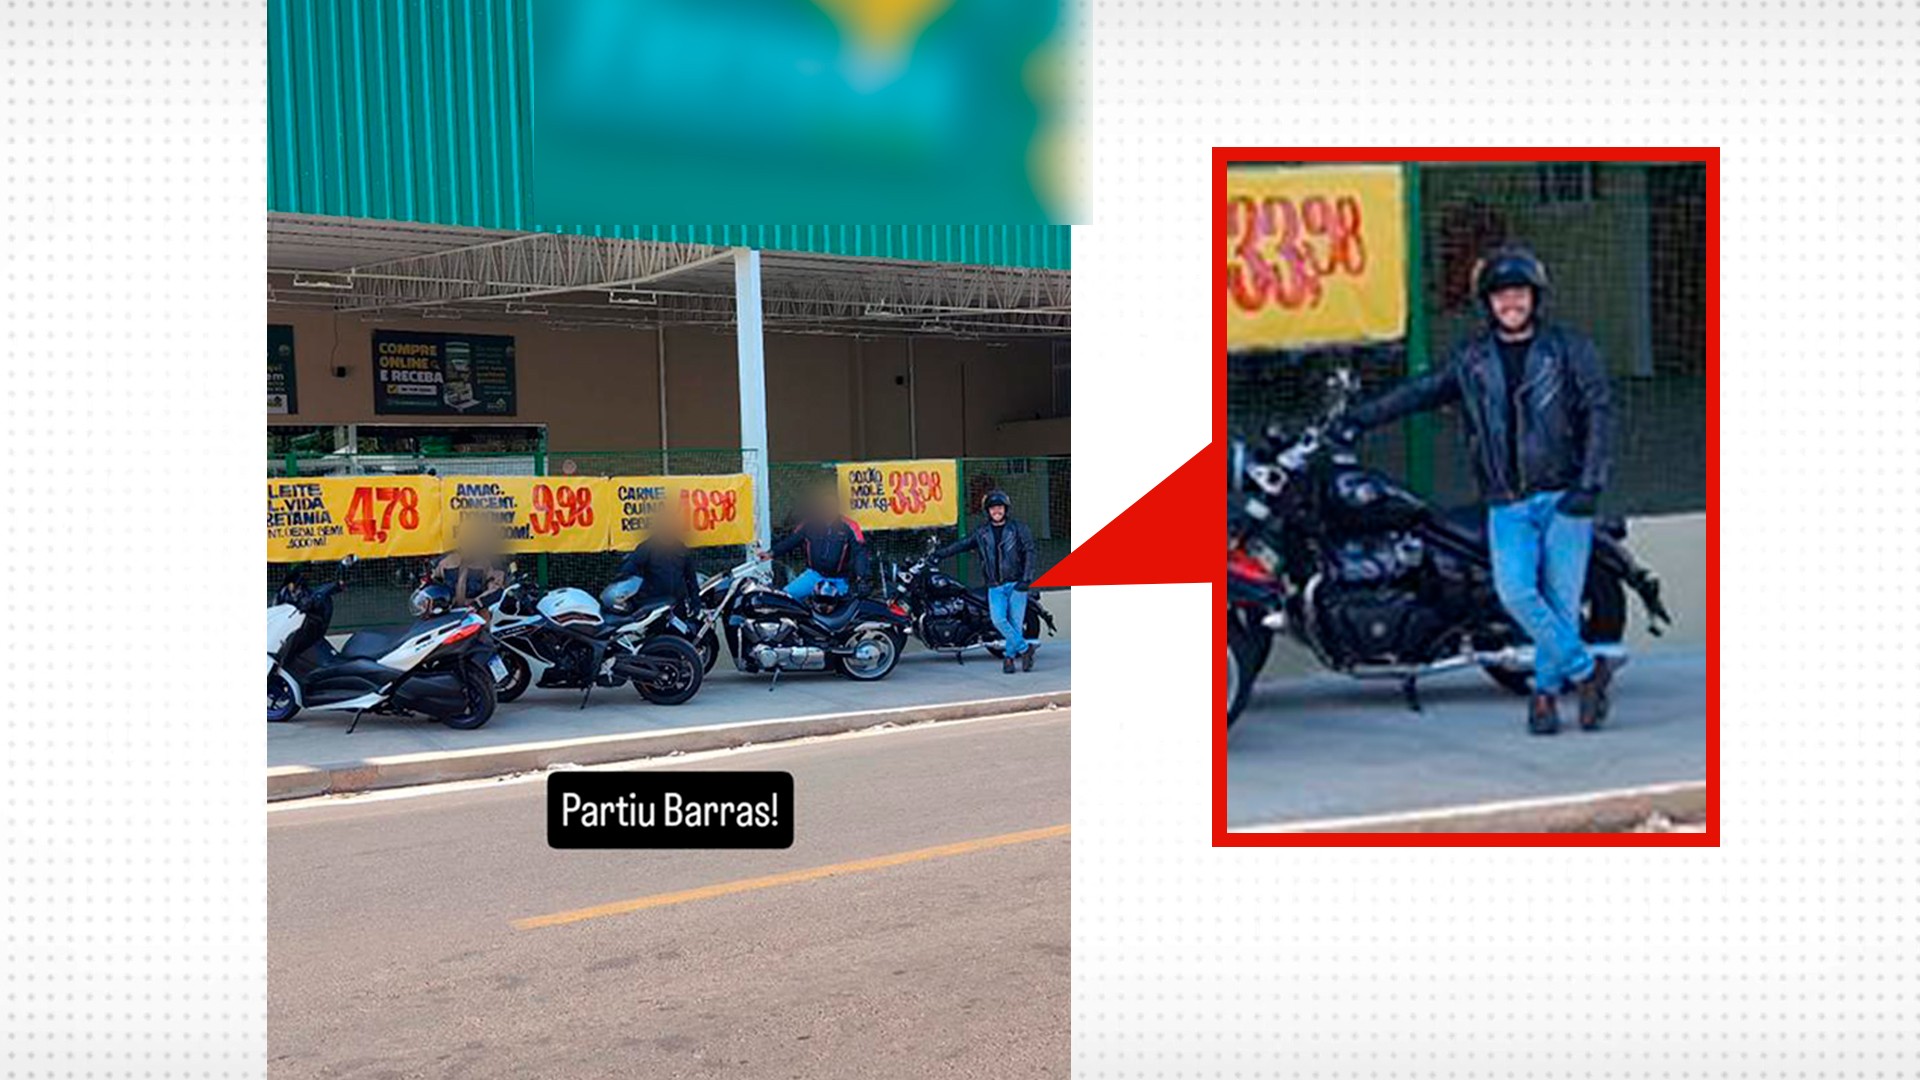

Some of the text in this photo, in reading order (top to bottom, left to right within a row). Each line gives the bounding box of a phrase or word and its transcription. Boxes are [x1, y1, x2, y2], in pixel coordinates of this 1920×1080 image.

[379, 342, 438, 357] COMPRE
[379, 356, 429, 370] ONLINE
[380, 369, 444, 384] E RECEBA
[268, 483, 322, 499] LEITE
[456, 483, 505, 497] AMAC.
[618, 486, 667, 501] CARNE
[889, 470, 942, 515] 33,98
[450, 496, 518, 510] CONCENT.
[529, 484, 594, 535] 9,98
[344, 486, 420, 544] 4,78
